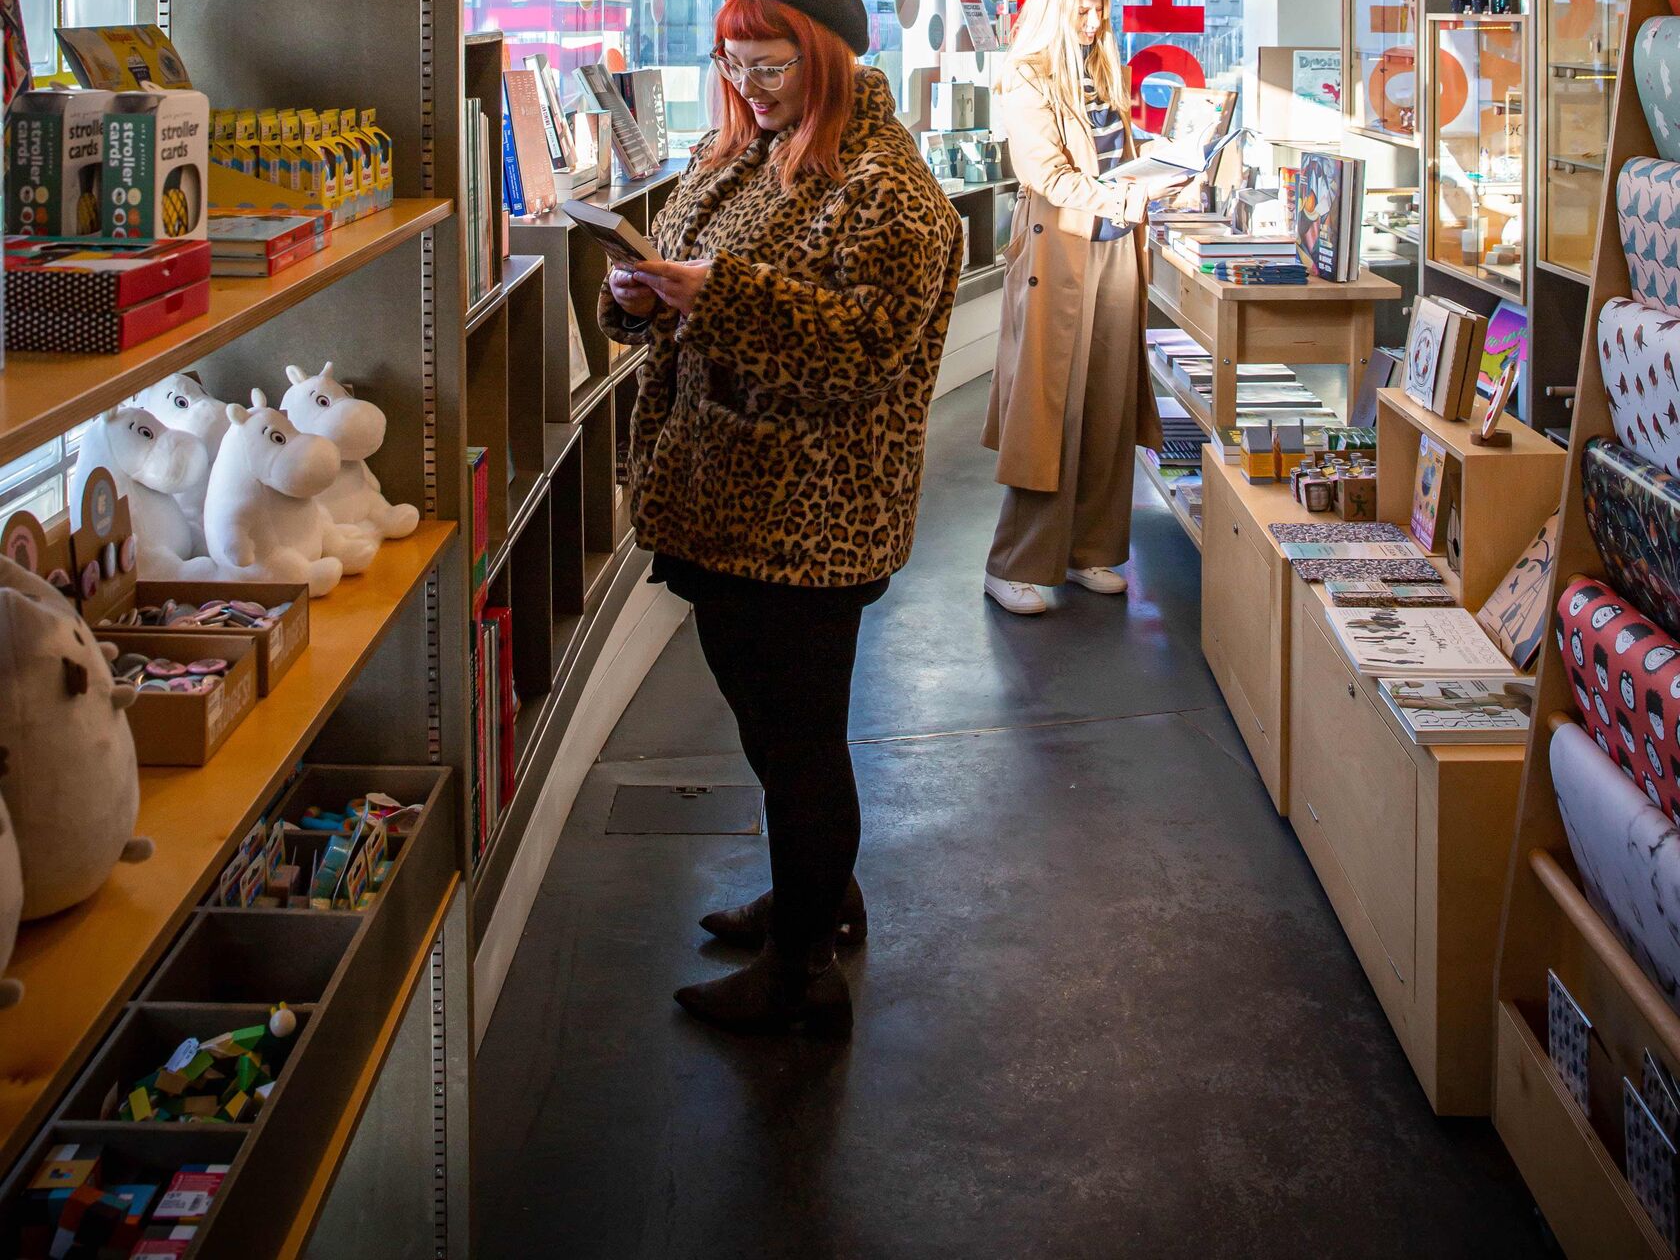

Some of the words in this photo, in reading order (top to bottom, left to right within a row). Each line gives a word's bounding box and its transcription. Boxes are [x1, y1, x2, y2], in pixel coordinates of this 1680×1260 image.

[69, 119, 103, 140] strolle
[161, 121, 200, 140] stroller
[17, 120, 29, 166] cards
[31, 120, 43, 185] stroller
[69, 139, 98, 160] cards
[109, 121, 122, 168] cards
[161, 141, 189, 161] cards
[122, 121, 135, 187] stroller
[1441, 716, 1468, 728] IS
